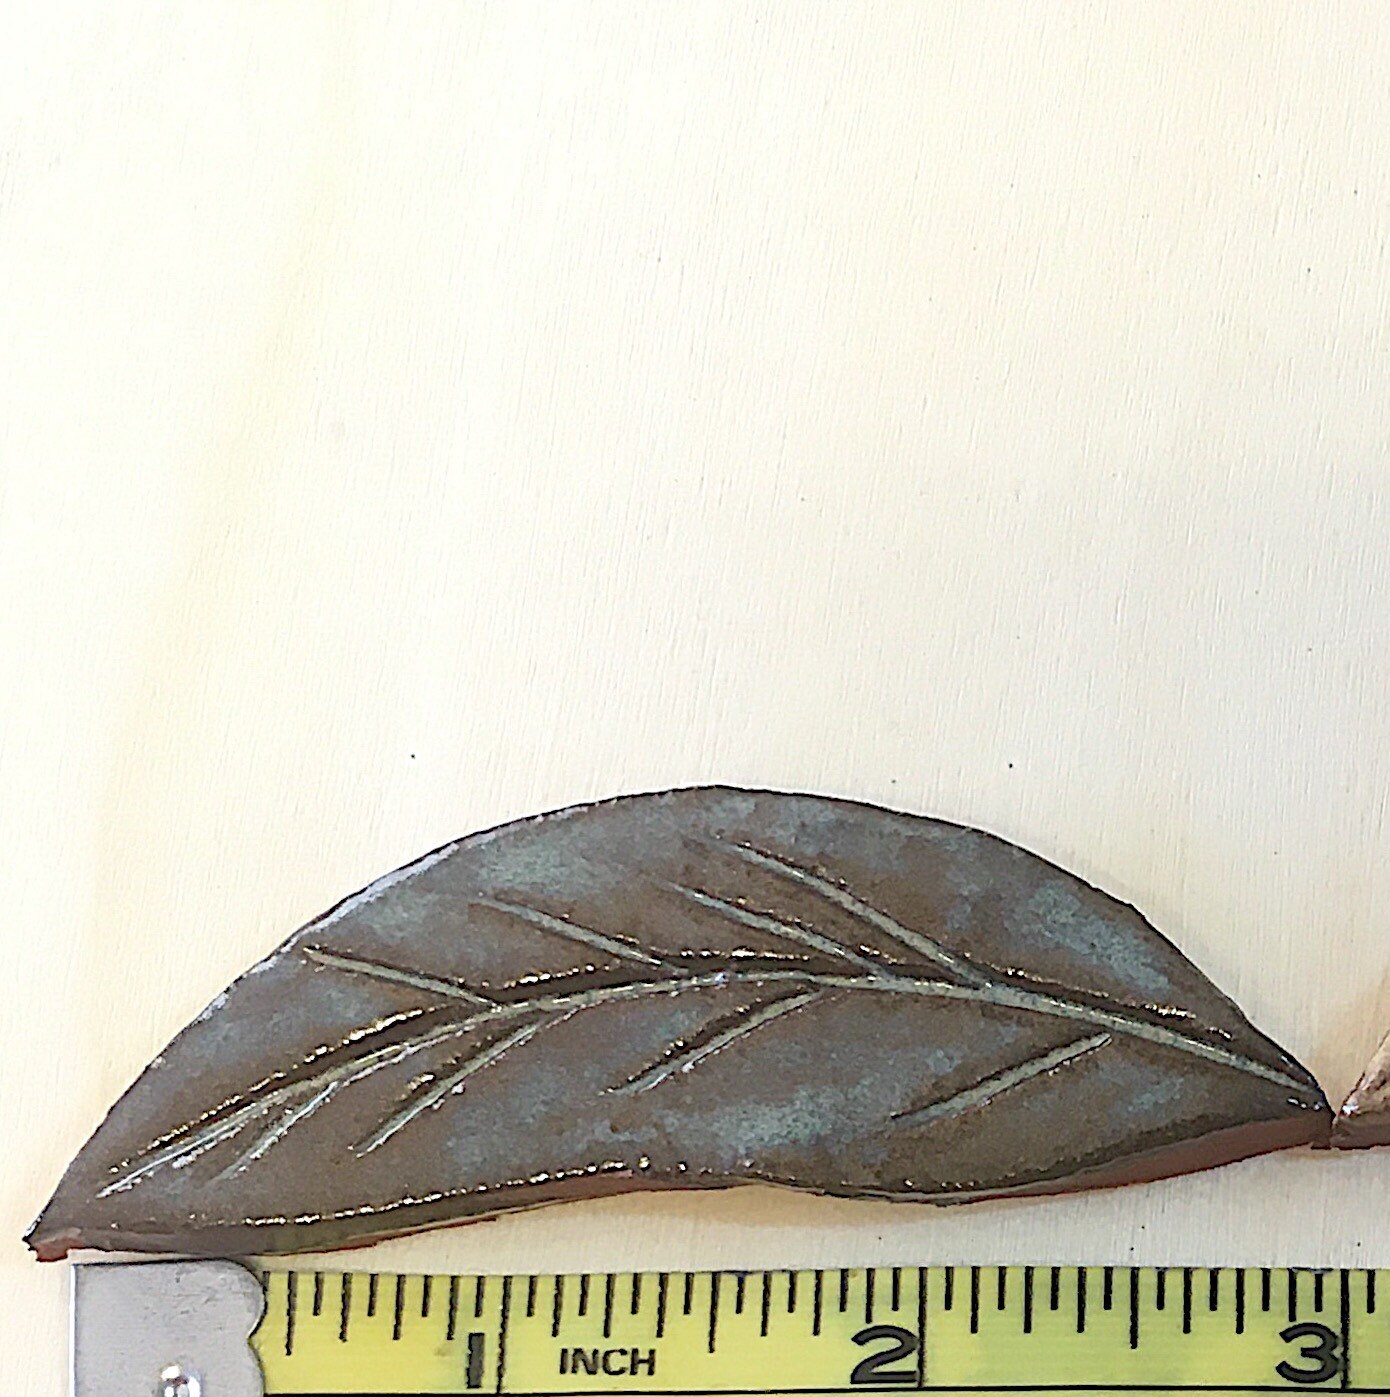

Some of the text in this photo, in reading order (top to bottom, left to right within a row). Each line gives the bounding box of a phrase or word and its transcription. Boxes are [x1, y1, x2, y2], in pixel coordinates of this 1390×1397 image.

[466, 1332, 486, 1389] 1
[558, 1347, 656, 1376] INCH
[850, 1325, 919, 1385] 2
[1276, 1323, 1343, 1383] 3
